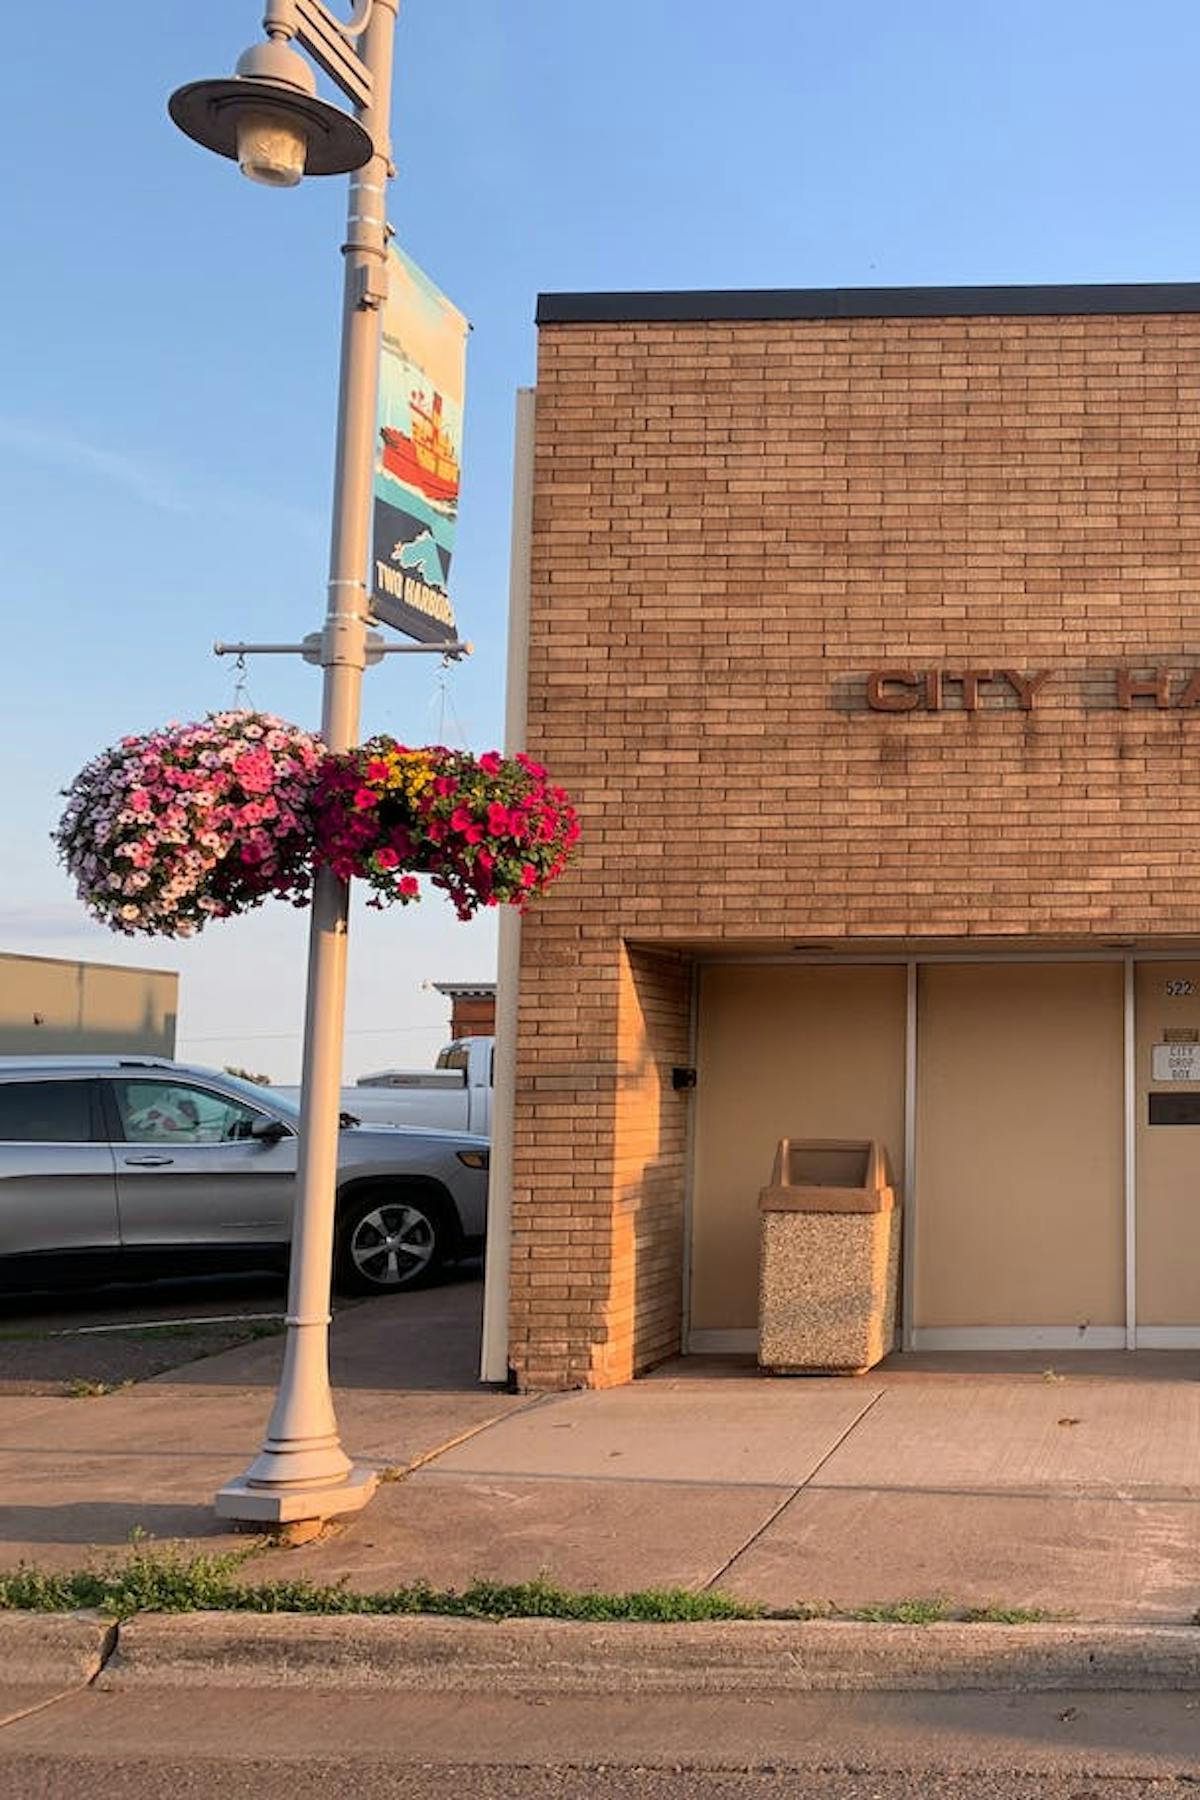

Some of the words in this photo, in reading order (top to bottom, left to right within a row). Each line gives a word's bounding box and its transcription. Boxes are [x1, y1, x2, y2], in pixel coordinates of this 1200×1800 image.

[376, 561, 404, 600] TWO
[866, 669, 1055, 711] CITY
[1166, 981, 1193, 996] 522
[1170, 1046, 1193, 1057] CITY
[1168, 1058, 1194, 1068] DROP
[1171, 1069, 1190, 1078] BOX
